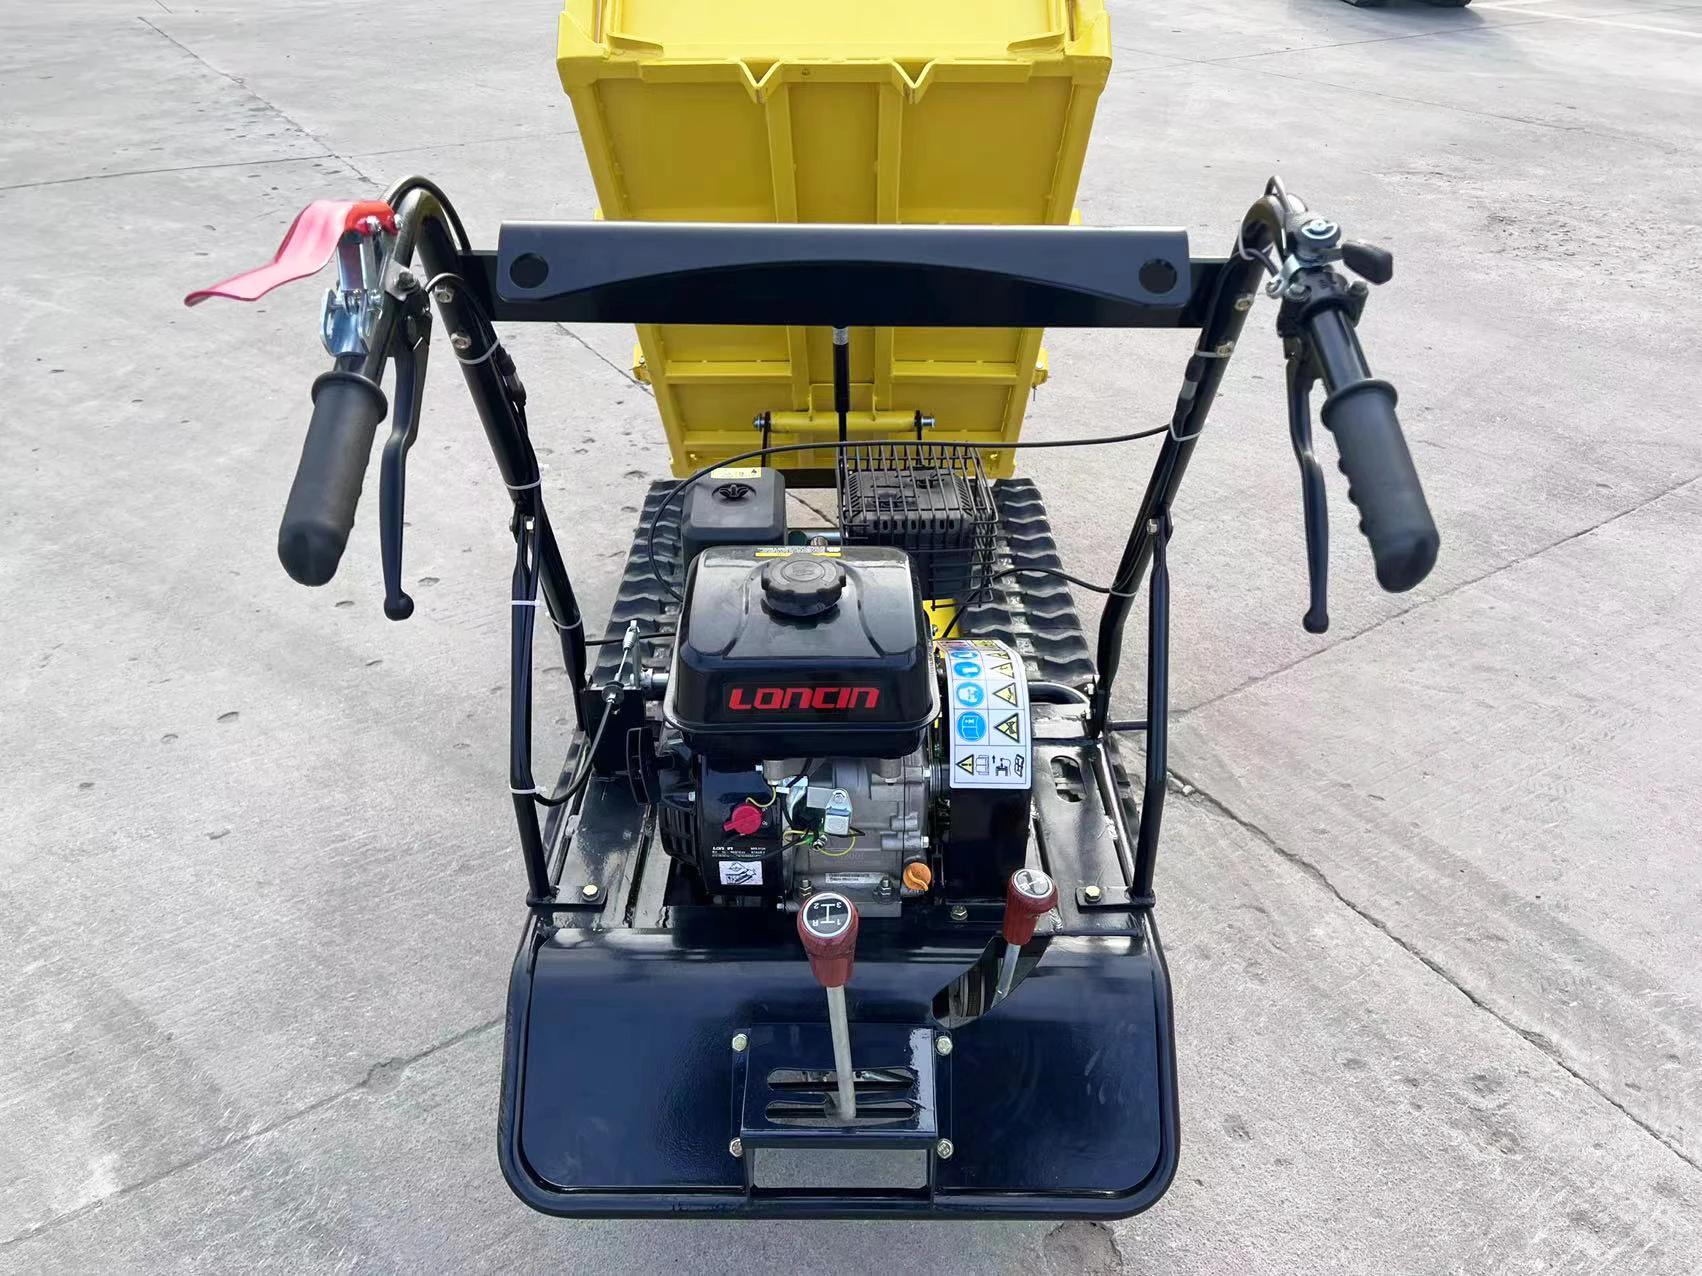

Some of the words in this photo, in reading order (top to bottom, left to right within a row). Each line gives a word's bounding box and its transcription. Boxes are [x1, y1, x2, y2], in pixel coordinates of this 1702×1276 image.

[813, 902, 820, 910] 2
[836, 901, 842, 909] 3
[812, 919, 819, 927] R
[836, 918, 842, 926] 1
